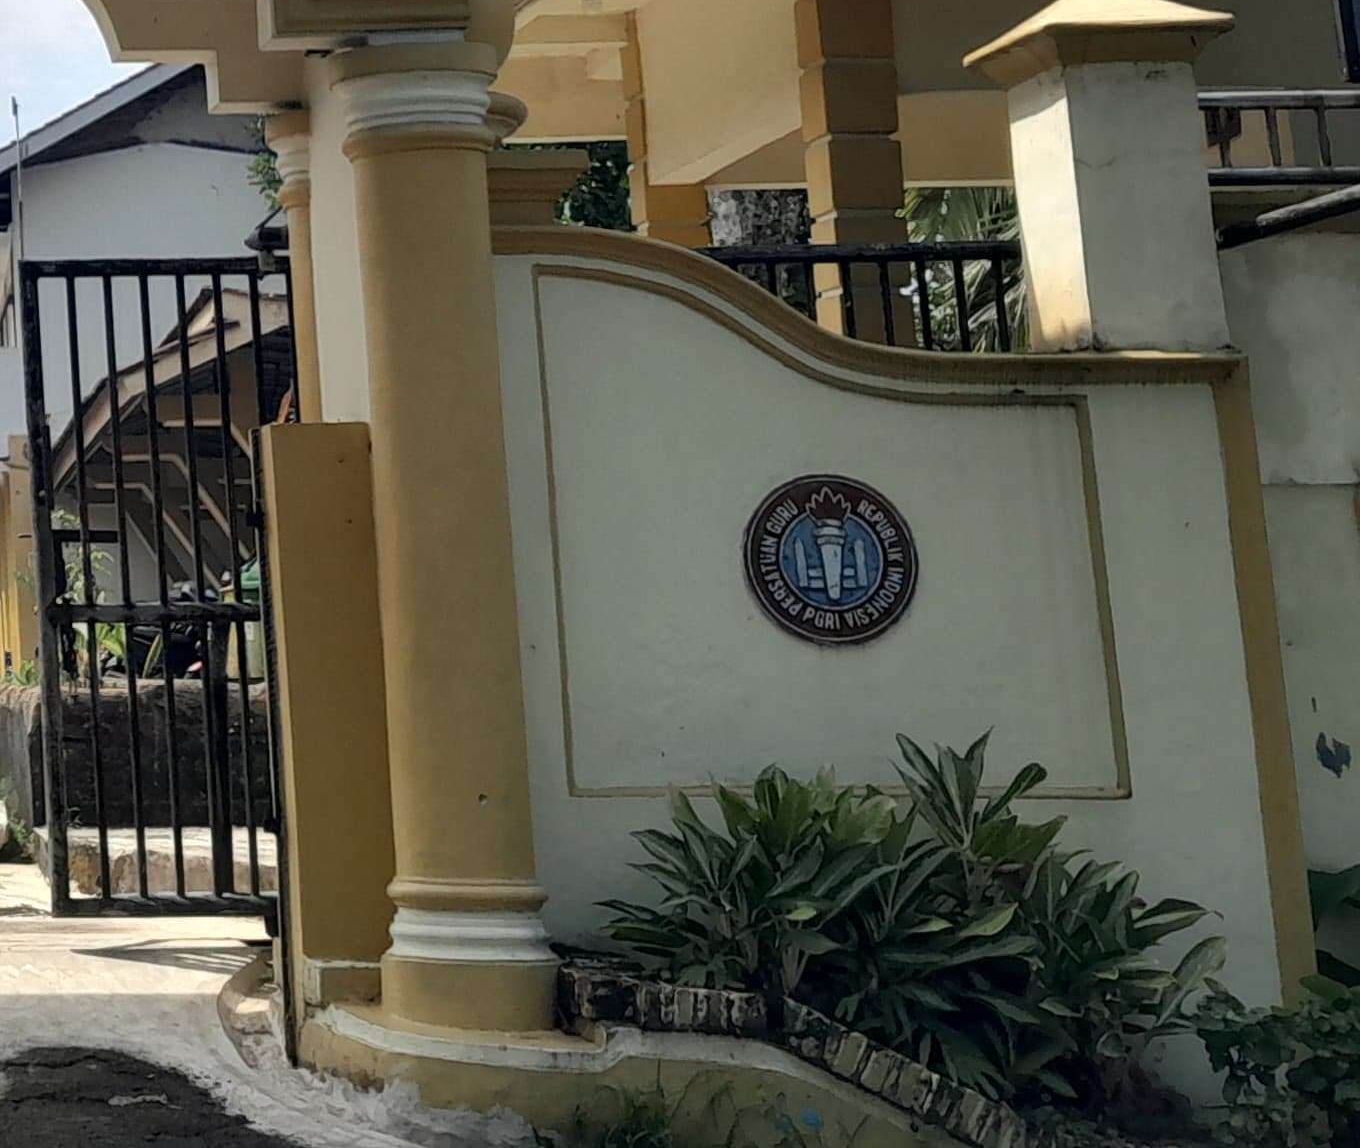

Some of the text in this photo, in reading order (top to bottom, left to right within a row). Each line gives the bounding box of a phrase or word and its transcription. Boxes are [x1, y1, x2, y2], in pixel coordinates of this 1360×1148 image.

[759, 498, 803, 616] PERSATUAN GURU
[843, 500, 905, 629] REPUBLIK INDONESIA
[802, 609, 841, 630] PGRI
